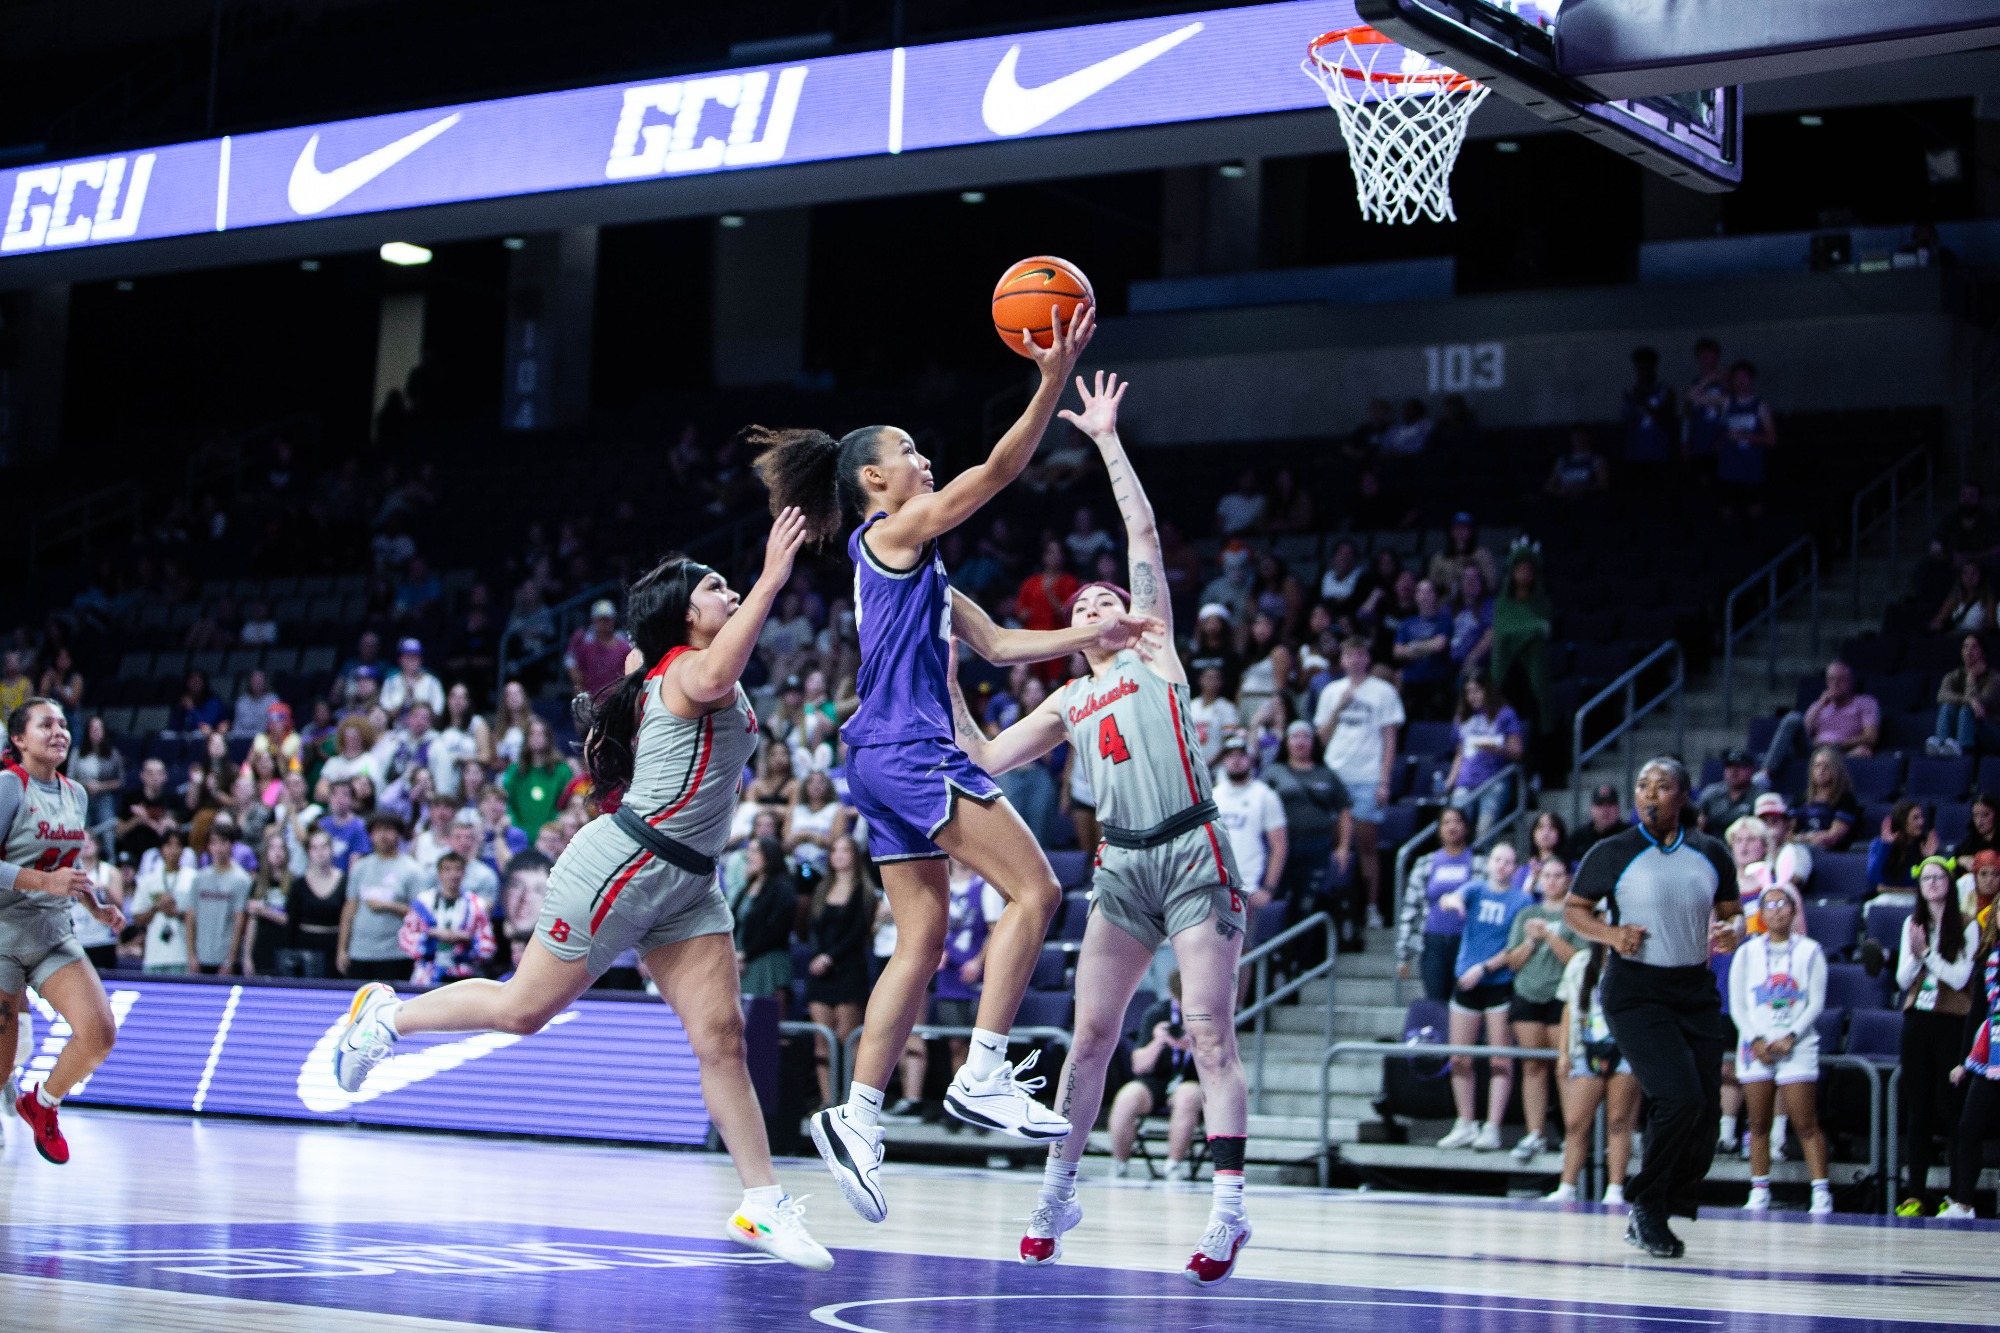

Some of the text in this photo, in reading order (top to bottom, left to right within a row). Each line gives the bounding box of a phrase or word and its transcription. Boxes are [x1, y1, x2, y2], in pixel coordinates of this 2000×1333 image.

[605, 66, 808, 179] GCU
[1, 153, 157, 250] GCU
[1424, 343, 1504, 394] 103
[1067, 676, 1139, 727] Redhawks
[1098, 713, 1131, 765] 4
[548, 917, 571, 943] B
